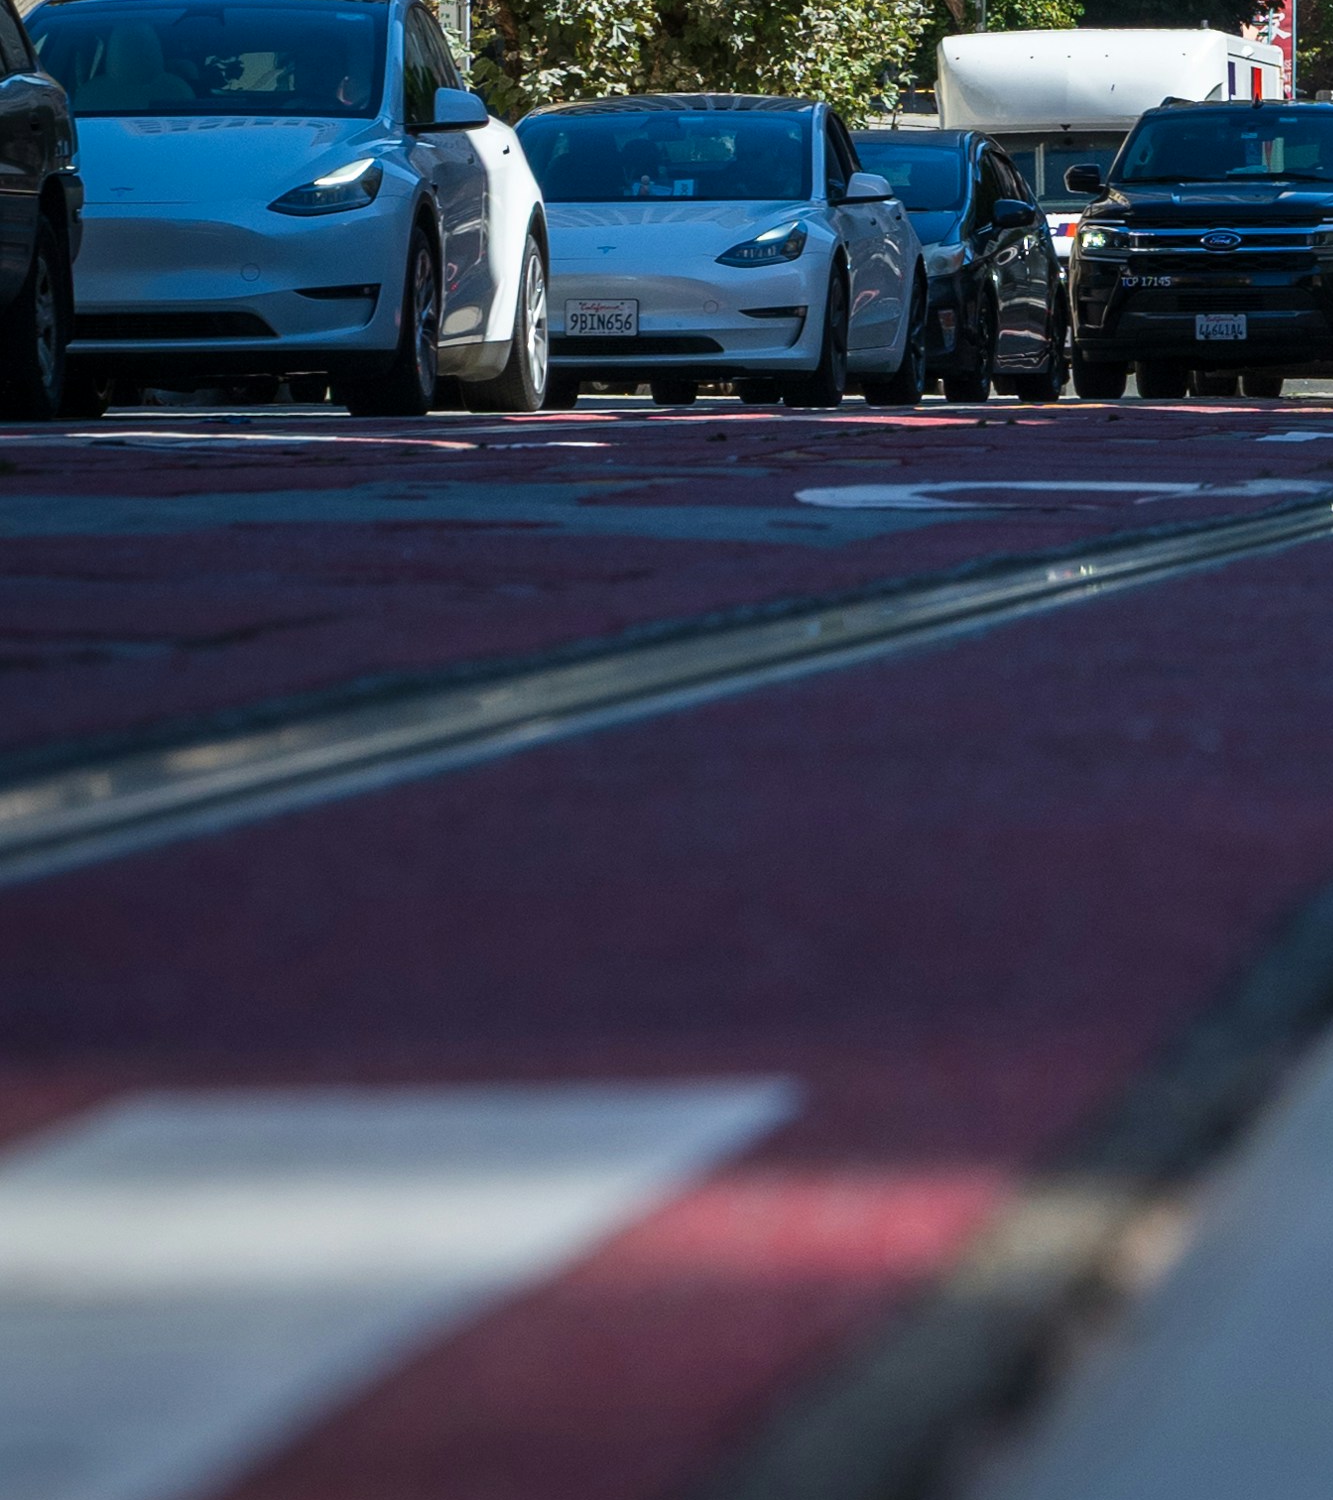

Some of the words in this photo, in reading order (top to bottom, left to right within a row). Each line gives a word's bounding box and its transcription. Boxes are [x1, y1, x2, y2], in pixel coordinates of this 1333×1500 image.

[1208, 235, 1232, 245] Ford
[1121, 276, 1139, 287] TCP
[1140, 276, 1172, 287] 17145
[570, 313, 633, 331] 9BIN656
[1199, 323, 1243, 336] 44641A4
